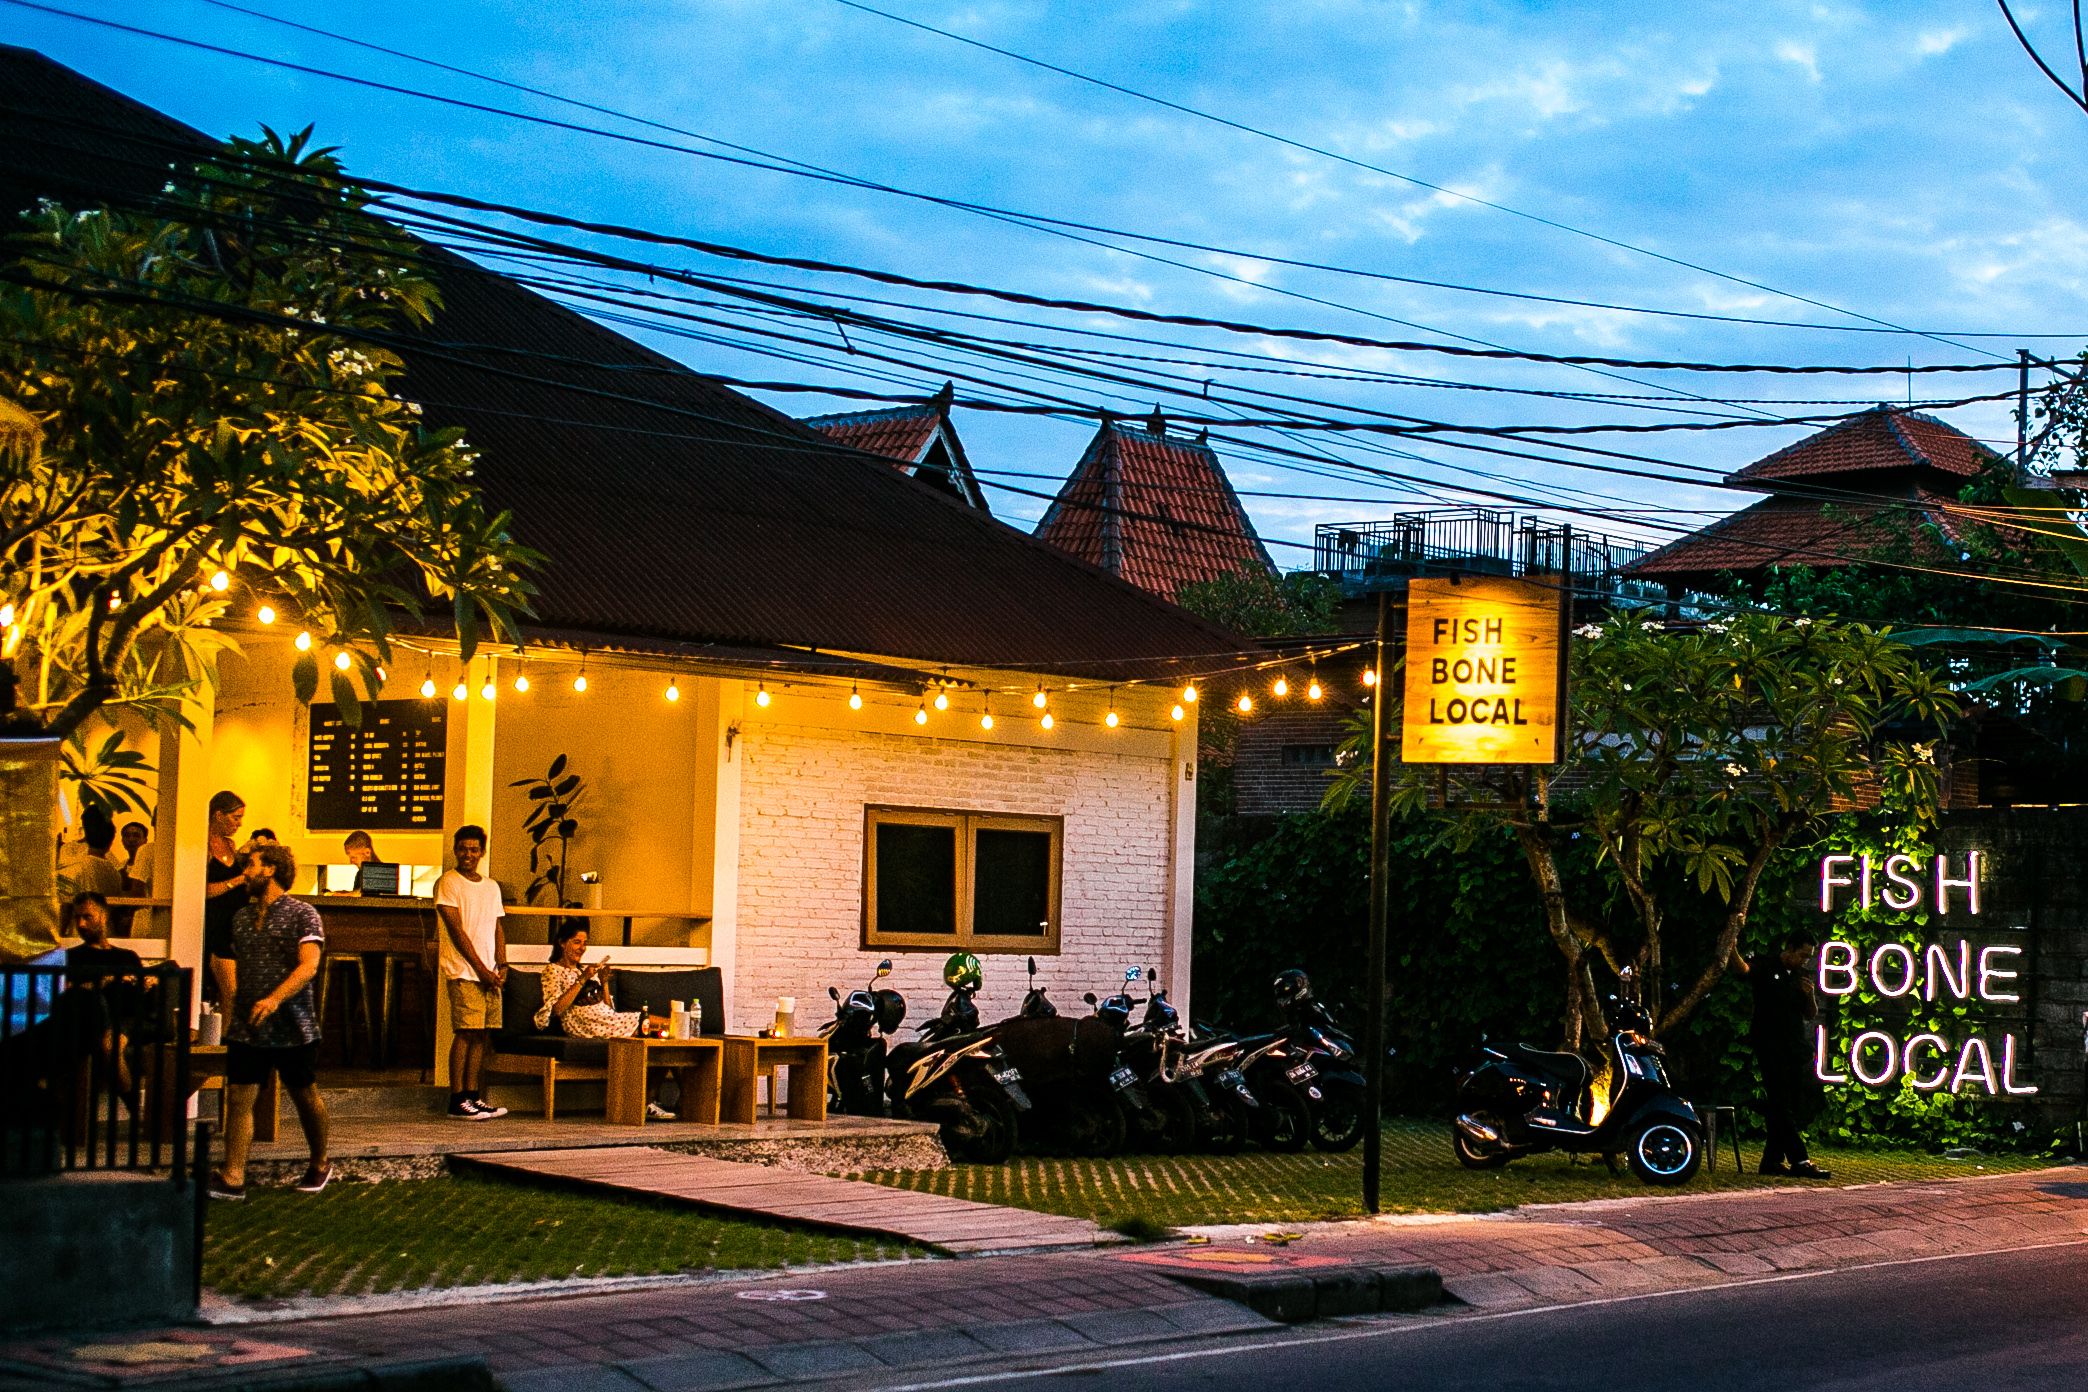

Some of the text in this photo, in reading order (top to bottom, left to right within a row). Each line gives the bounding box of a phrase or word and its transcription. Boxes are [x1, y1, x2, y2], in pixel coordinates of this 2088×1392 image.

[1433, 618, 1502, 645] FISH
[1431, 657, 1516, 684] BONE
[1429, 698, 1528, 725] LOCAL
[1819, 851, 1981, 915] FISH
[1818, 939, 2022, 1002] BONE
[1815, 1024, 2039, 1095] LOCAL
